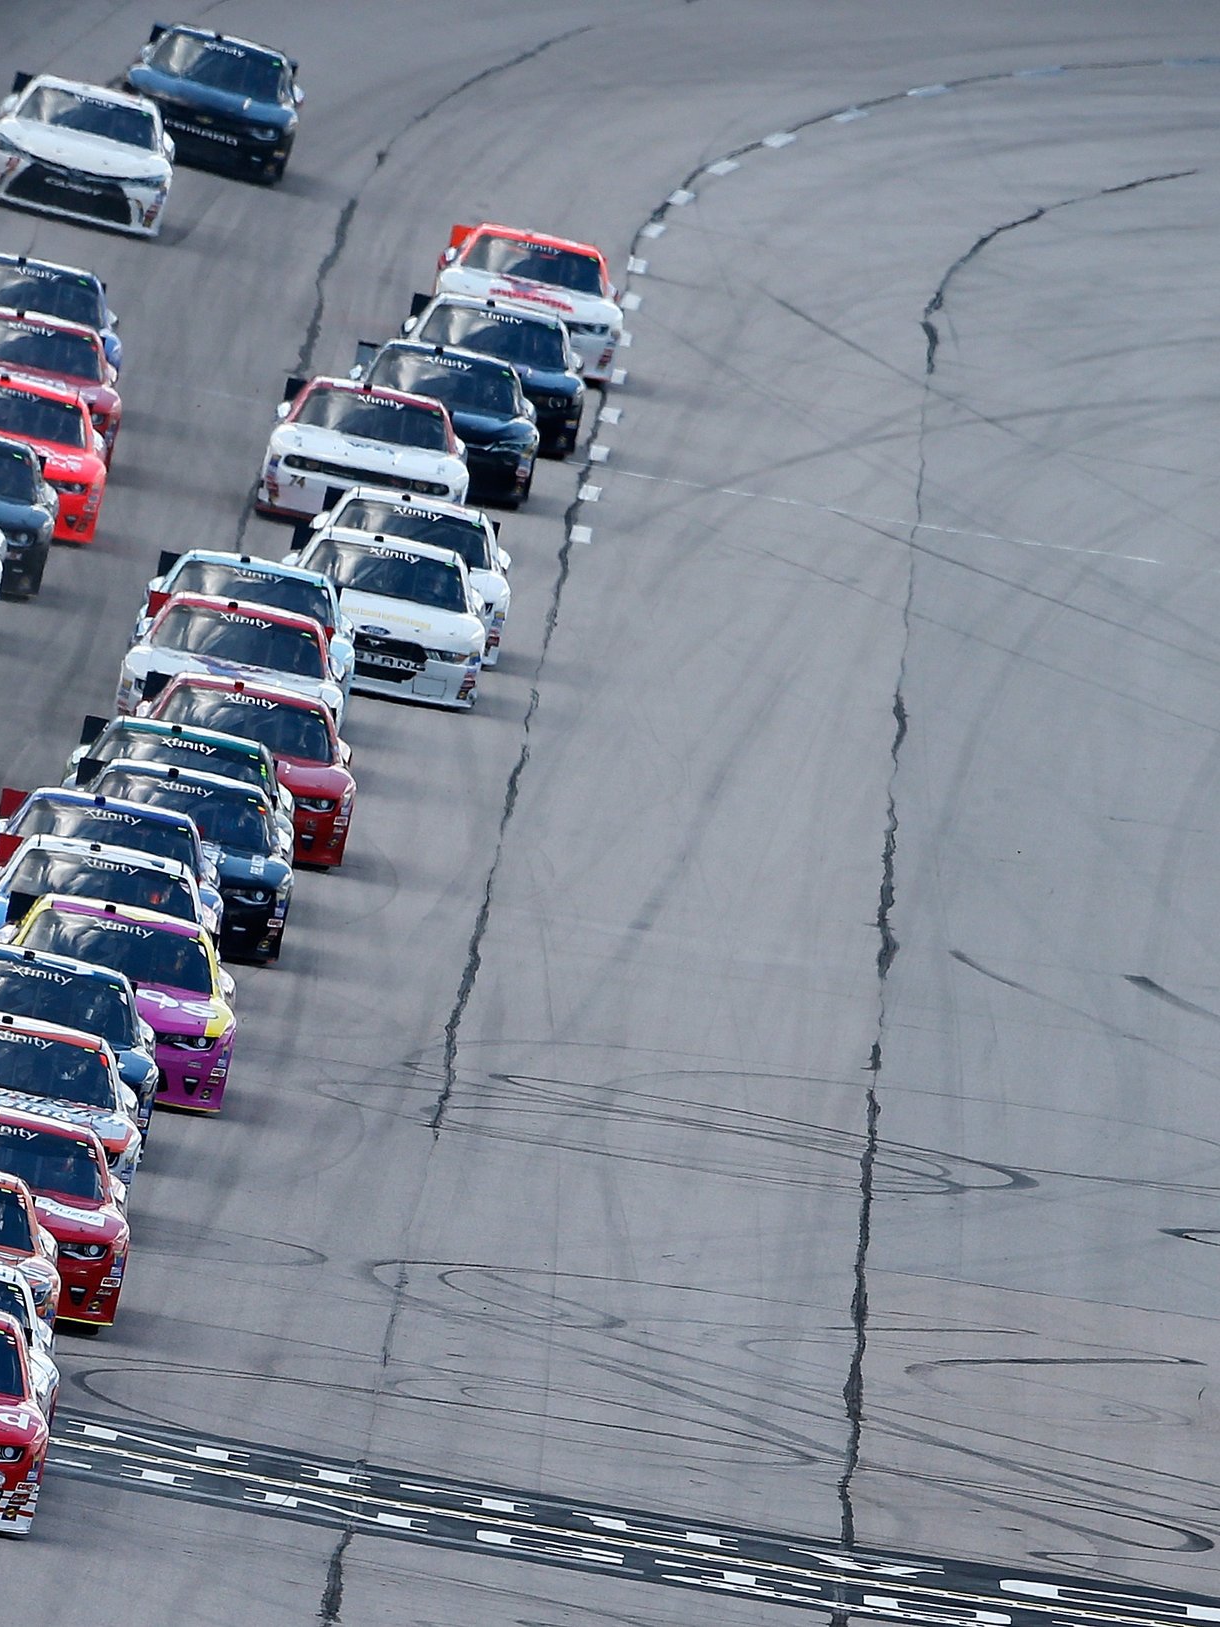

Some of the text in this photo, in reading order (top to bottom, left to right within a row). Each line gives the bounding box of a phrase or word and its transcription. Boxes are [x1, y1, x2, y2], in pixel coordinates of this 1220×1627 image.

[478, 310, 523, 326] xfinity
[424, 354, 473, 371] xfinity
[356, 393, 405, 411] xfinity
[392, 503, 443, 521] xfinity
[369, 545, 421, 564] xfinity
[219, 611, 273, 630] xfinity
[354, 650, 427, 673] STANG
[224, 691, 279, 710] xfinity
[161, 736, 218, 756] xfinity
[157, 779, 214, 798] xfinity
[84, 807, 142, 826] xfinity
[81, 856, 140, 876] xfinity
[93, 918, 154, 938] xfinity
[11, 963, 73, 986] xfinity
